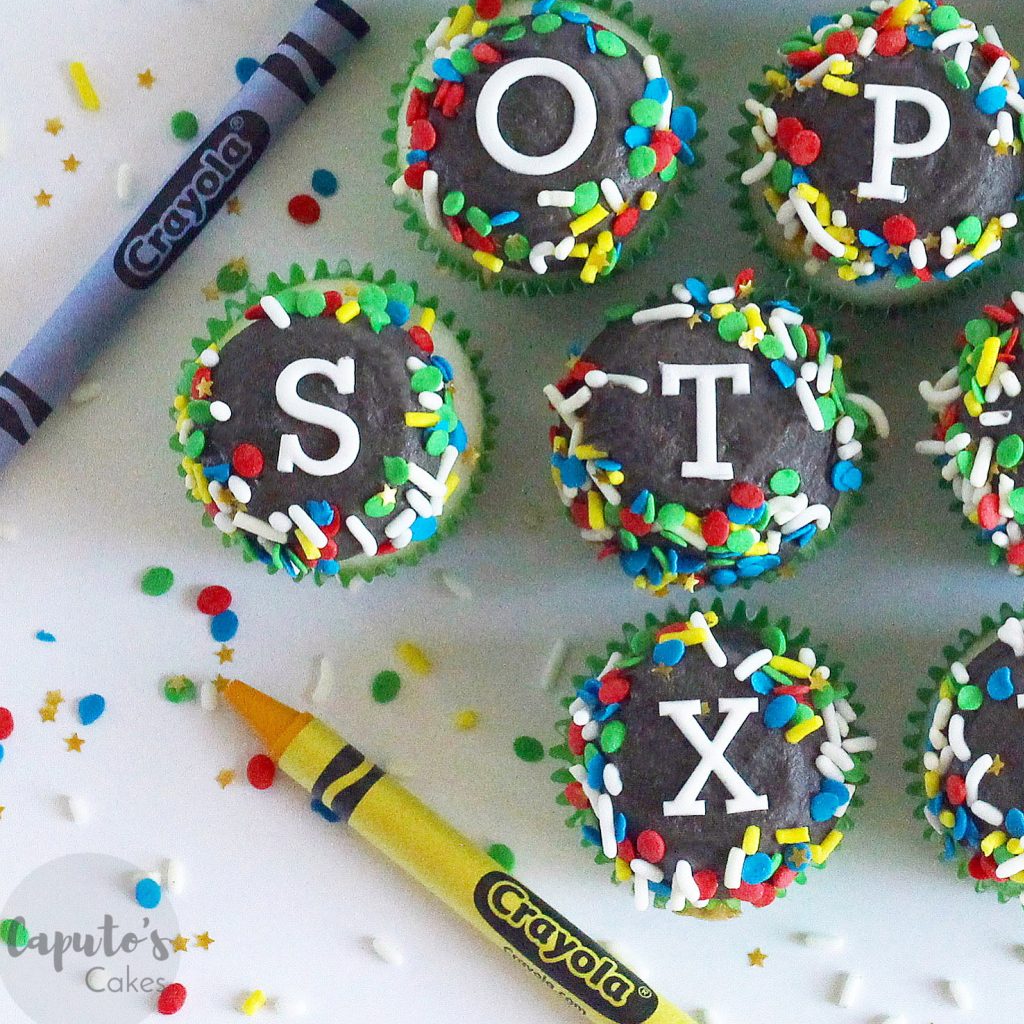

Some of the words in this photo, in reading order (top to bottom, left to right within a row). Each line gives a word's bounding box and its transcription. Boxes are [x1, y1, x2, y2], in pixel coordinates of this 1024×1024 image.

[476, 58, 596, 175] O
[858, 84, 950, 203] P
[124, 132, 252, 275] Crayola
[276, 356, 359, 476] S
[658, 361, 750, 480] T
[659, 698, 768, 816] X
[487, 881, 635, 1007] Crayola
